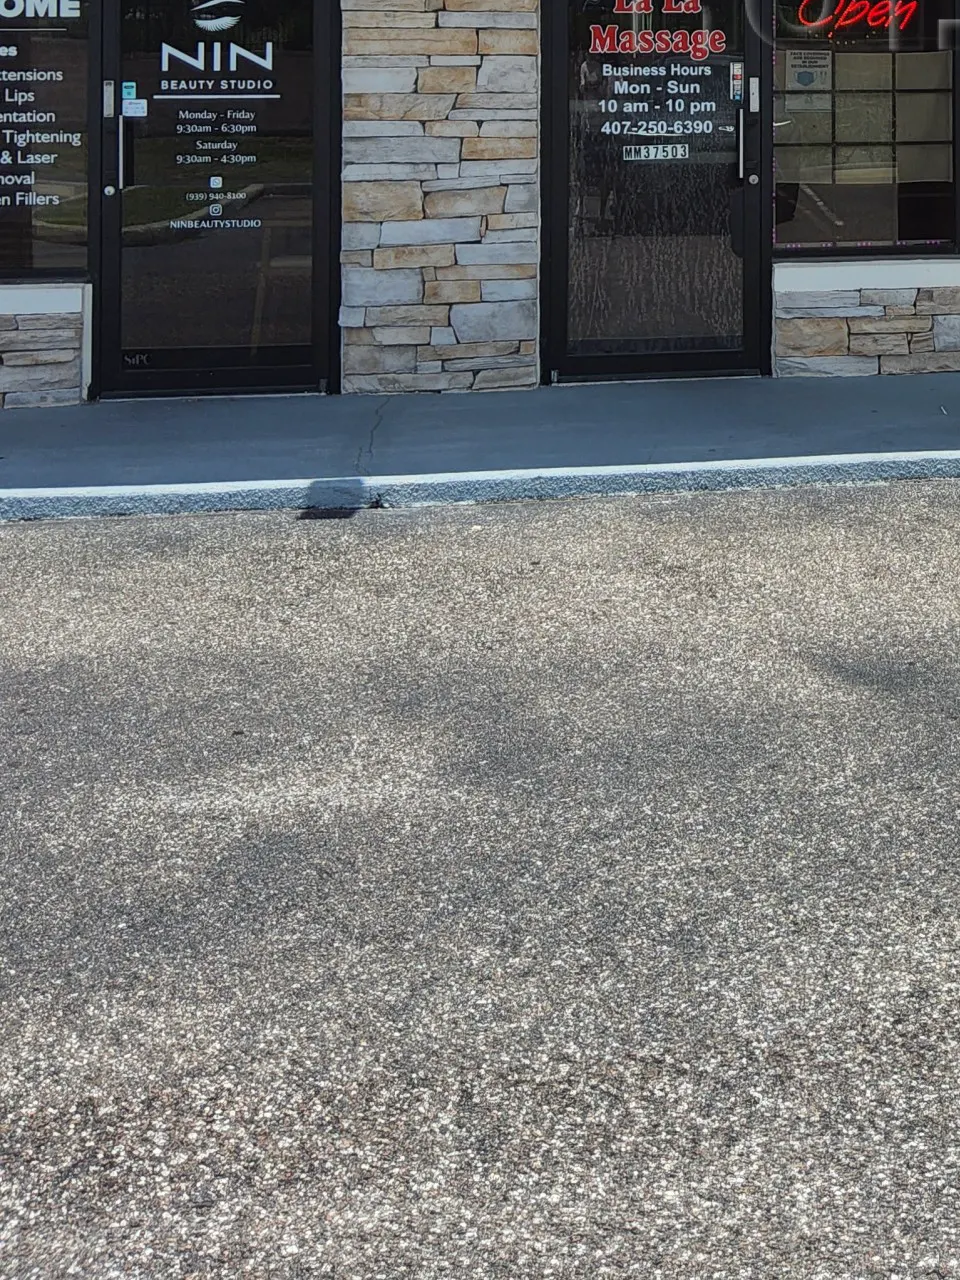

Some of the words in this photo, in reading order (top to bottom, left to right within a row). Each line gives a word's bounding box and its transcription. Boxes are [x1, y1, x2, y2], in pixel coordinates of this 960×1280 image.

[589, 24, 726, 61] Massage
[161, 42, 273, 72] NIN
[0, 69, 63, 81] tensions
[602, 64, 667, 76] Business
[670, 64, 712, 76] Hours
[161, 80, 215, 90] BEAUTY
[220, 80, 273, 90] STUDIO
[614, 81, 650, 94] Mon
[667, 81, 701, 94] Sun
[5, 88, 35, 105] Lips
[598, 100, 618, 113] 10
[623, 102, 648, 113] am
[665, 99, 685, 112] 10
[690, 101, 716, 115] pm
[178, 110, 218, 121] Monday
[227, 110, 255, 120] Friday
[176, 124, 212, 134] 9:30am
[221, 123, 257, 134] 6:30pm
[600, 120, 713, 135] 407-250-6390
[2, 130, 81, 147] Tightening
[196, 140, 238, 151] Saturday
[0, 150, 12, 164] &
[17, 150, 57, 164] Laser
[176, 154, 212, 164] 9:30am
[220, 154, 257, 164] 4:30pm
[624, 146, 688, 159] MM37503
[16, 192, 60, 206] Fillers
[186, 192, 207, 200] (939)
[209, 192, 246, 200] 940-8100
[170, 220, 261, 228] NINBEAUTYSTUDIO
